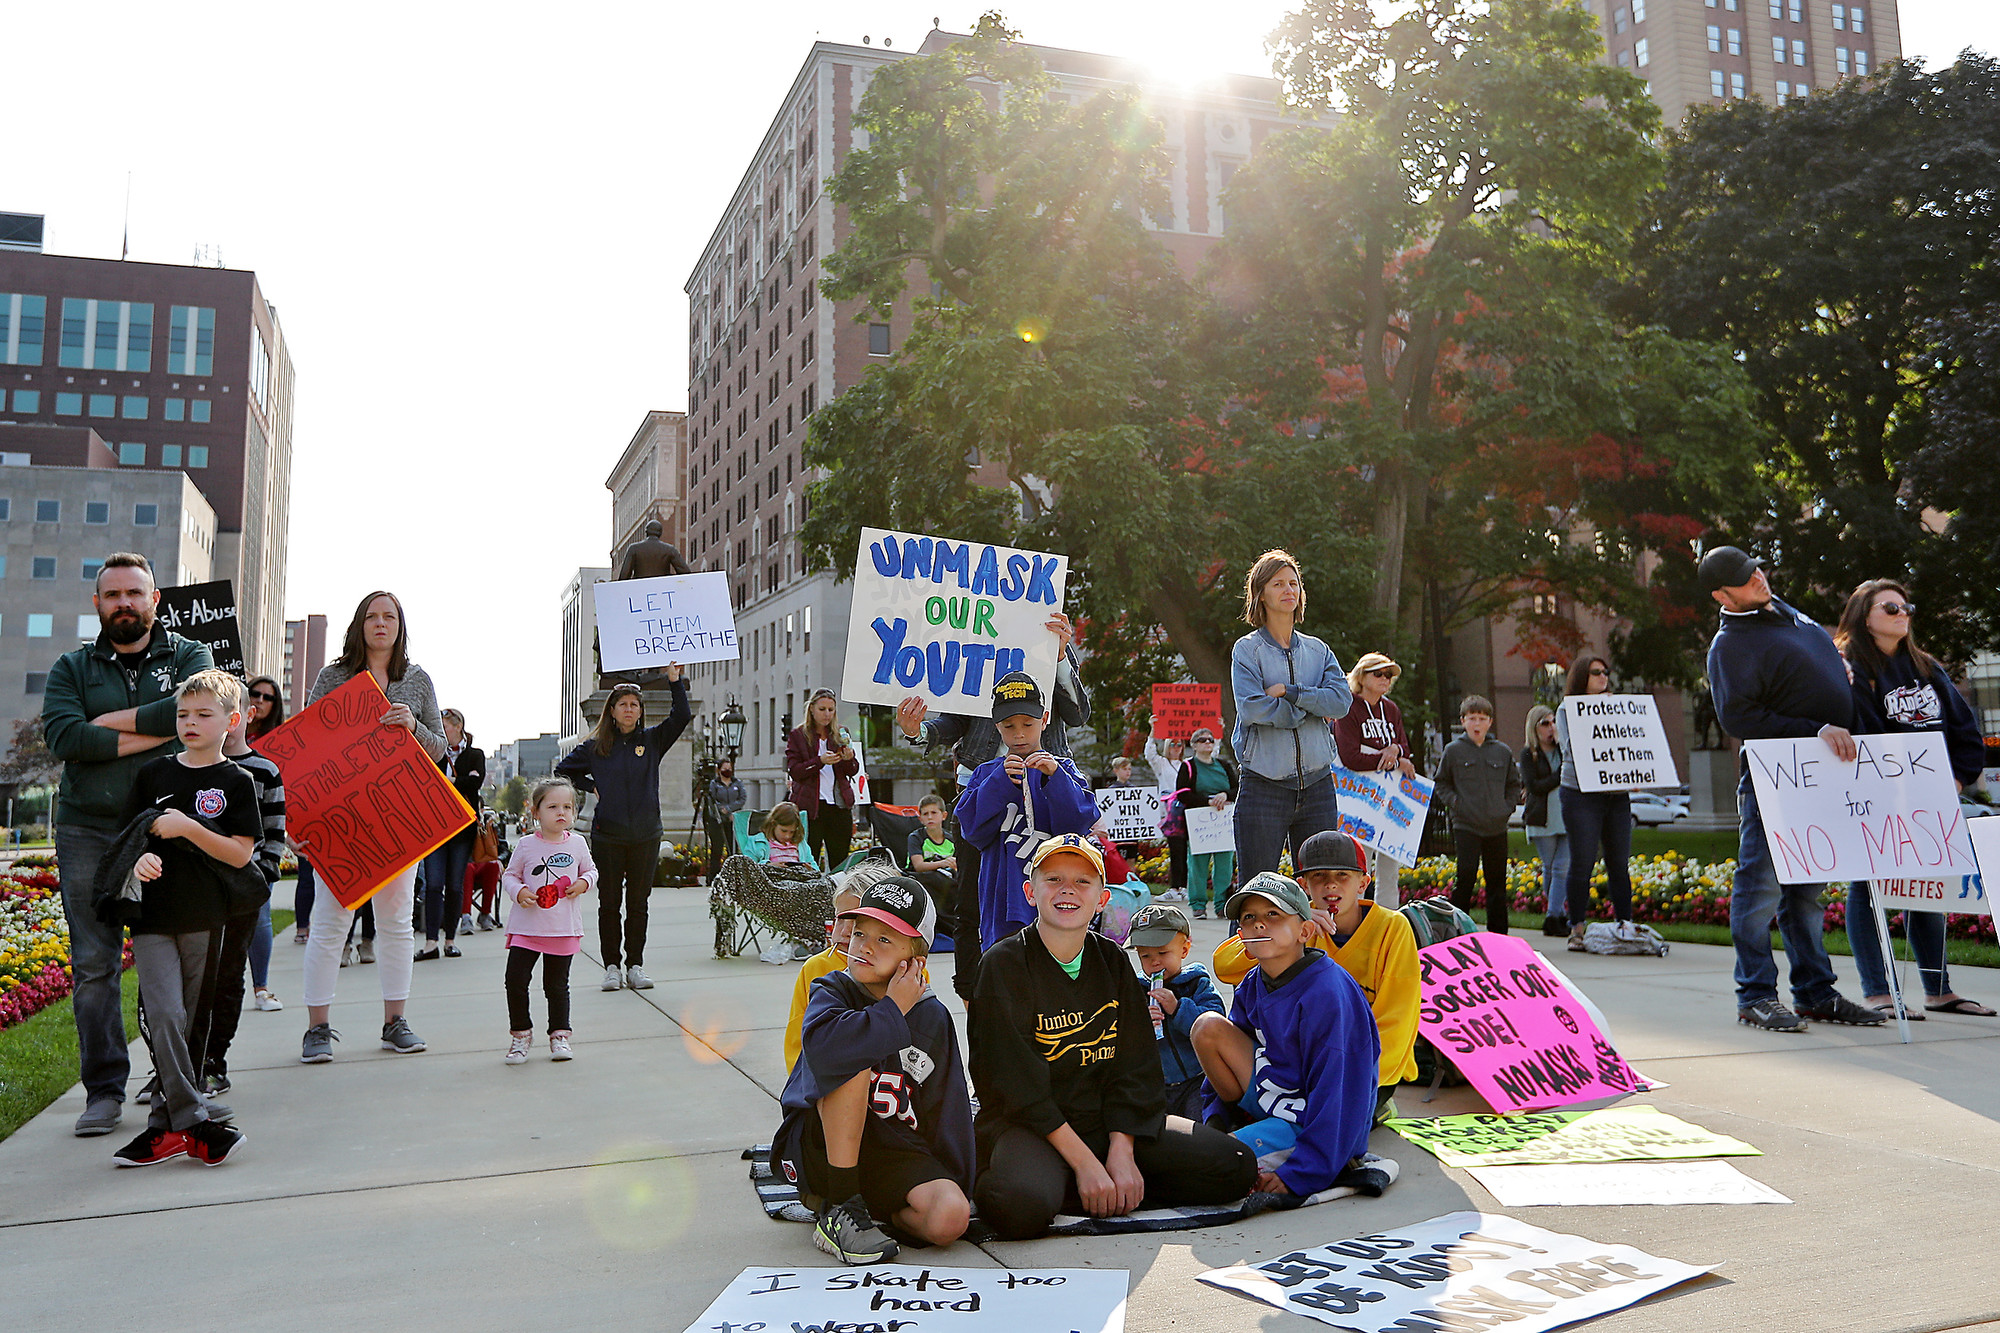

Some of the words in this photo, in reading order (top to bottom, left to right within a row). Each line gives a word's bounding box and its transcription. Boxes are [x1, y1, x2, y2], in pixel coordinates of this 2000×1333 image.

[870, 535, 1058, 605] UNMASK
[628, 591, 675, 613] LET
[640, 615, 702, 635] THEM
[926, 596, 999, 638] OUR
[634, 629, 738, 655] BREATHE
[871, 617, 1026, 697] YOUTH
[1003, 690, 1026, 699] TECH
[1577, 701, 1625, 716] Protect
[1628, 701, 1647, 715] Our
[262, 716, 306, 763] ET
[319, 688, 386, 730] OUR
[1592, 724, 1646, 739] Athletes
[1591, 747, 1615, 762] Let
[1618, 746, 1654, 762] Them
[1751, 743, 1819, 790] WE
[285, 723, 408, 823] ATHLETES
[1599, 769, 1656, 785] Breathe!
[1098, 795, 1114, 812] WE
[1115, 789, 1142, 800] PLAY
[1146, 793, 1159, 810] TO
[1400, 779, 1430, 804] Our
[1845, 791, 1873, 816] for
[1119, 805, 1140, 815] WIN
[1388, 800, 1411, 827] before
[297, 752, 462, 895] BREATH
[1107, 826, 1155, 839] WHEEZE
[1062, 835, 1080, 847] H
[1337, 814, 1367, 839] too
[1377, 831, 1415, 863] Late
[1773, 824, 1836, 878] NO
[1861, 808, 1974, 874] MASK
[1420, 937, 1493, 985] PLAY
[1420, 971, 1516, 1024] SOCCER
[1036, 1009, 1083, 1031] Junior
[1474, 1114, 1567, 1124] PLAY
[1411, 1125, 1558, 1139] HOCKEY
[1224, 1252, 1347, 1287] LET
[1325, 1234, 1415, 1260] US
[747, 1273, 801, 1295] I
[825, 1270, 968, 1293] Skate
[997, 1275, 1068, 1291] too
[1504, 1255, 1663, 1299] FREE
[869, 1291, 980, 1313] hard
[1289, 1282, 1387, 1314] BE
[710, 1321, 766, 1333] to
